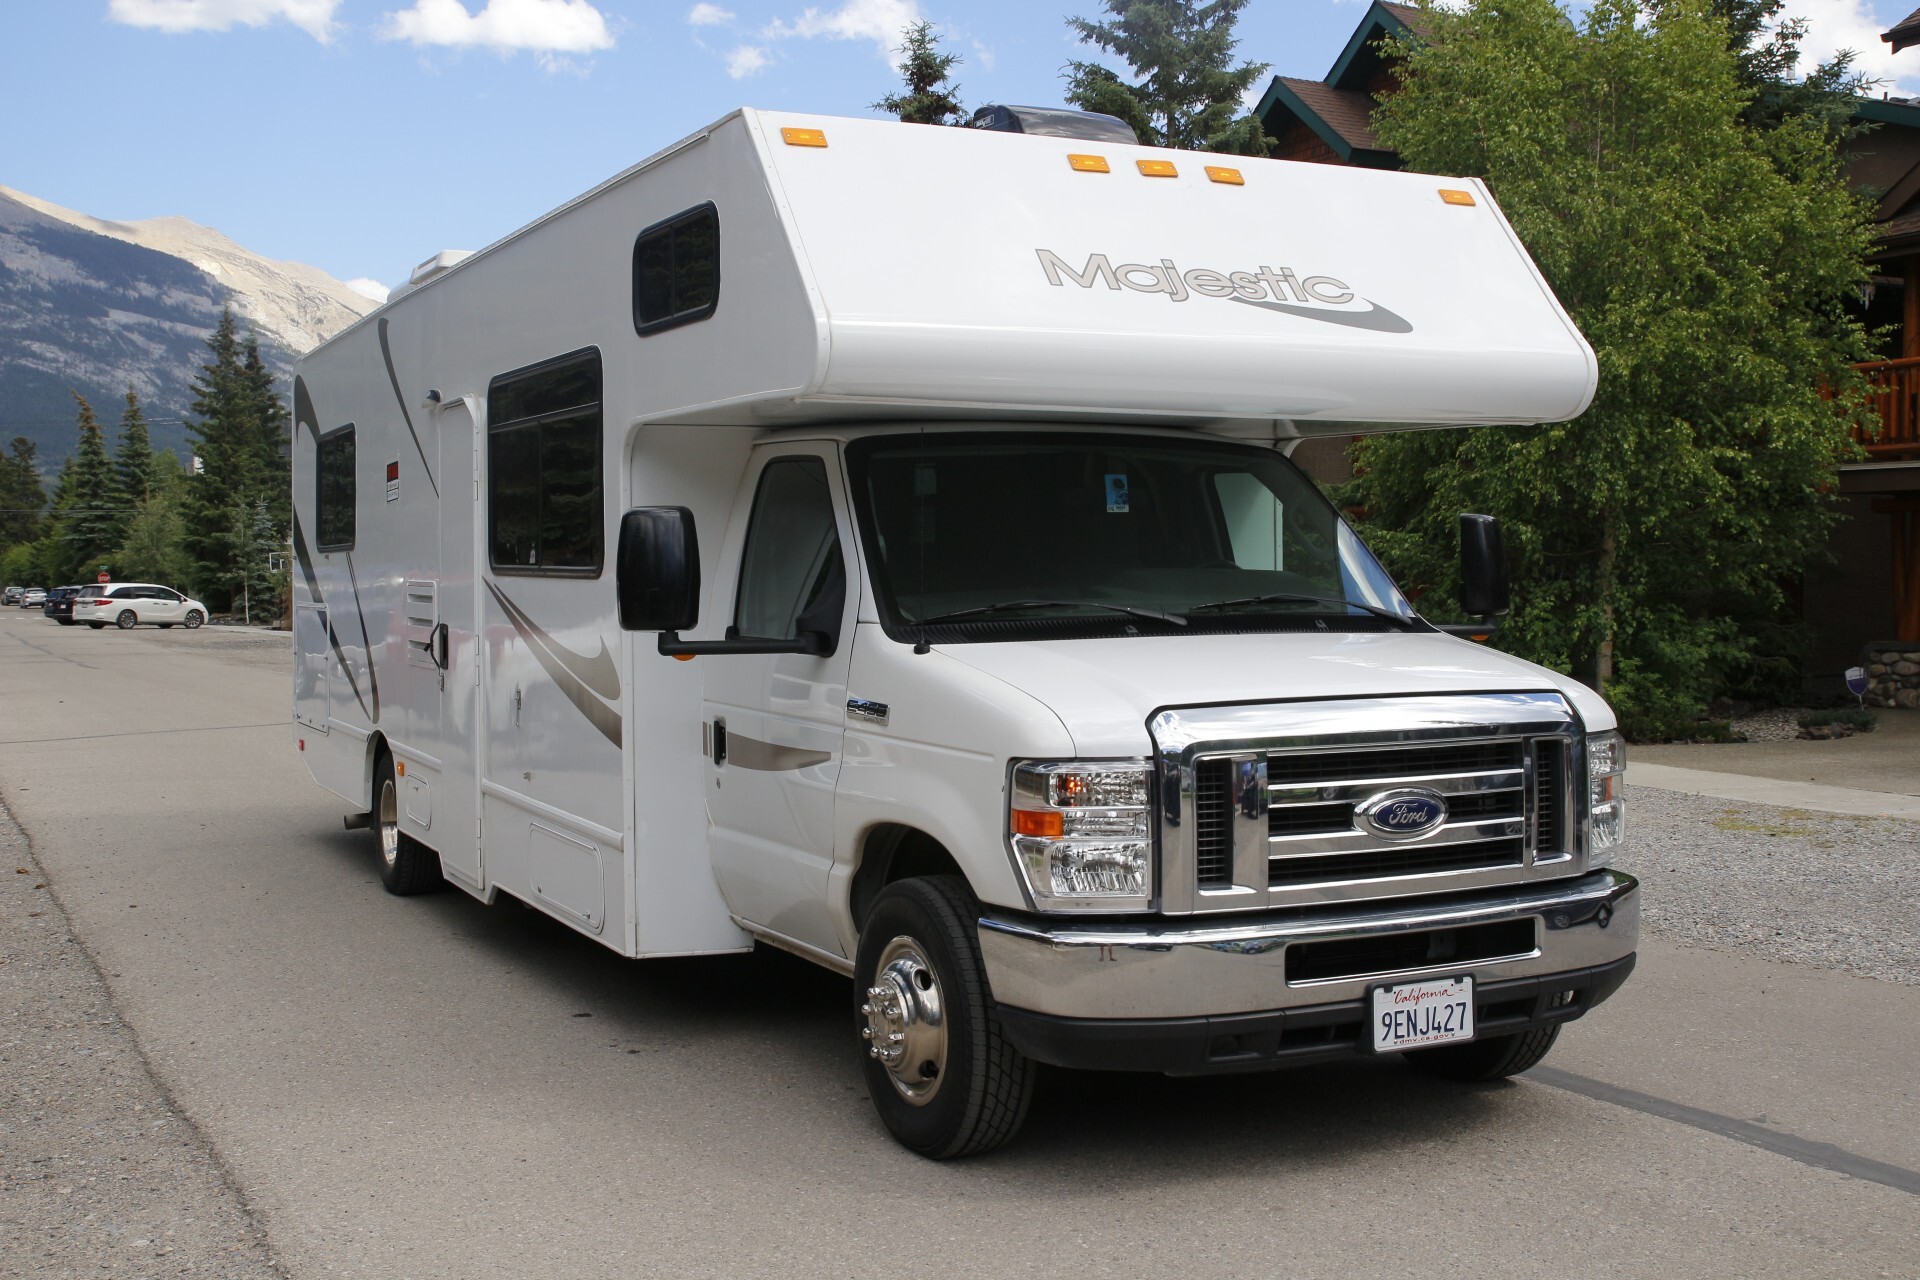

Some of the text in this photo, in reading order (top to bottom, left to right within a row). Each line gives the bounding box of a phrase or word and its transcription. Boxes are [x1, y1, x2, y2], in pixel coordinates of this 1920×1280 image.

[1035, 248, 1355, 304] Majestic
[1388, 802, 1428, 825] Ford
[1393, 985, 1455, 1006] California
[1381, 1001, 1467, 1042] 9ENJ427
[1399, 1033, 1450, 1045] dmv.ca.gov
